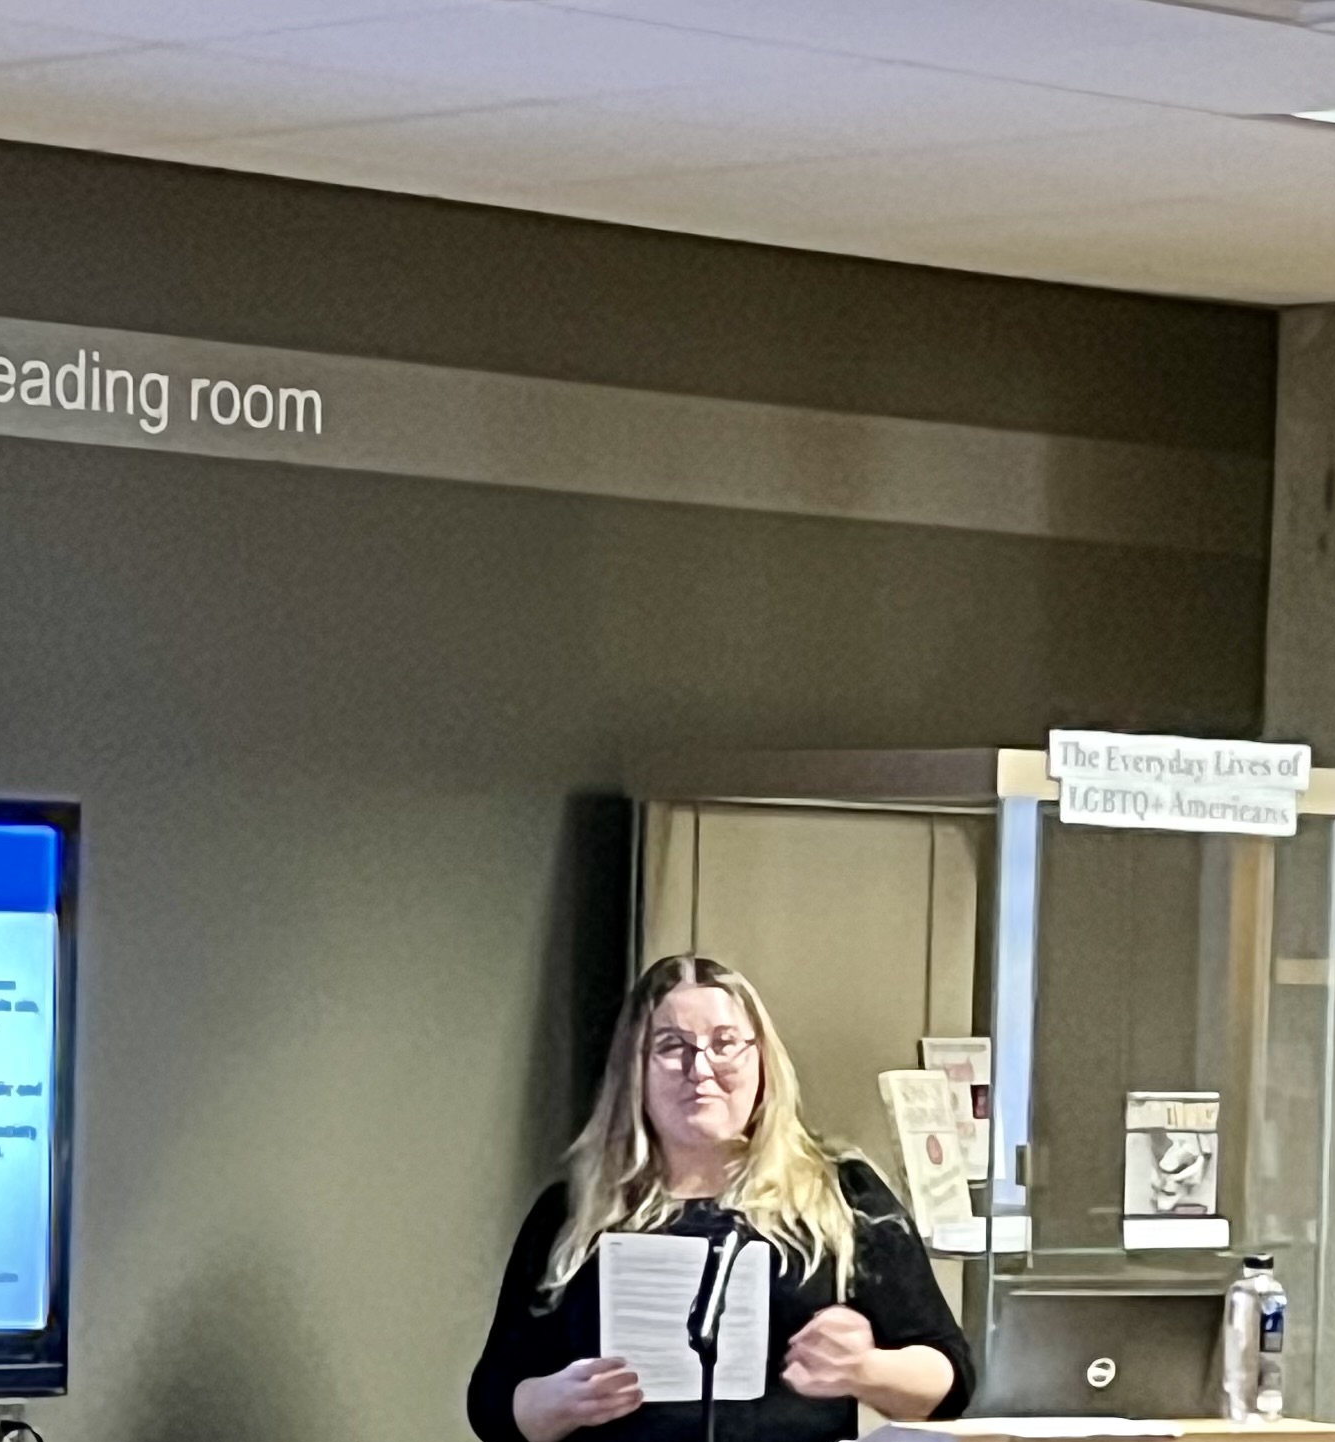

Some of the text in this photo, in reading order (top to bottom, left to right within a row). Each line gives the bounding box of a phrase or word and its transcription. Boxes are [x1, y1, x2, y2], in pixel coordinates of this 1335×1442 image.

[190, 378, 322, 435] room
[1059, 741, 1303, 783] The Everyday Lives of
[1069, 785, 1290, 826] LGBTQ+ Americans
